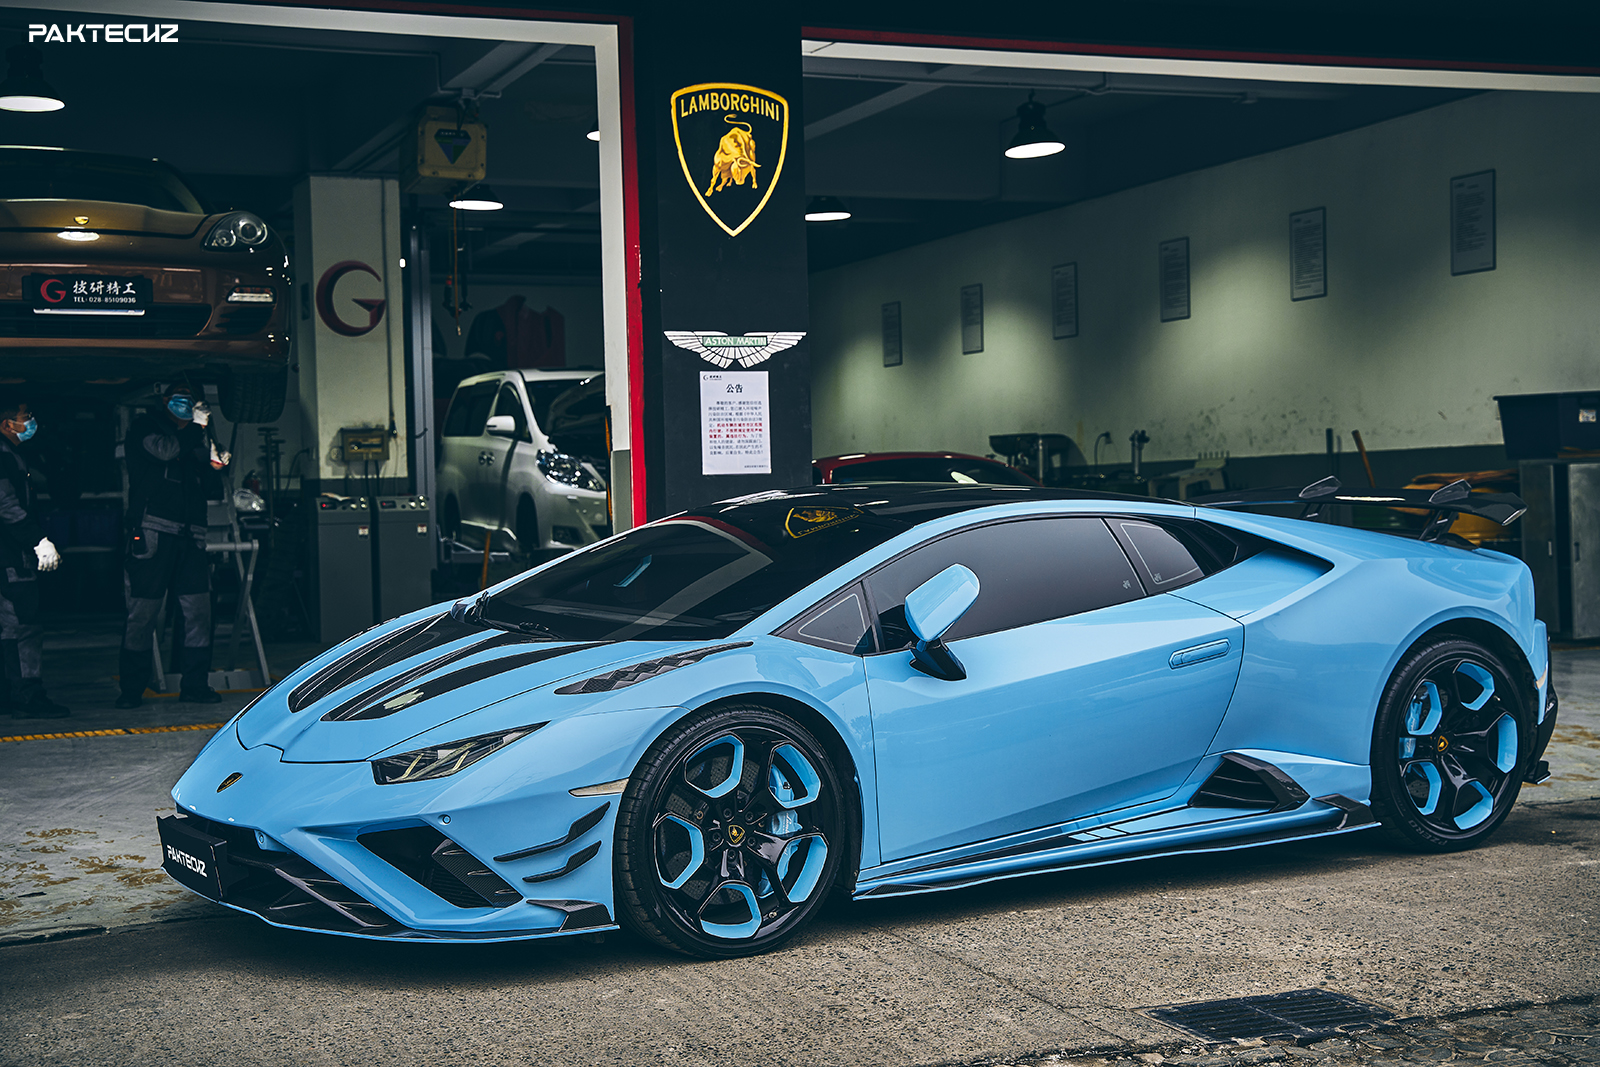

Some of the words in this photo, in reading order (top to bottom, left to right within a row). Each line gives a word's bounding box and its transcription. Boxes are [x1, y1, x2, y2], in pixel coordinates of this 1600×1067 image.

[680, 92, 780, 122] LAMBORGHINI
[73, 280, 136, 295] 技研精工
[705, 337, 734, 346] ASTON
[736, 337, 767, 346] MARTIN
[725, 383, 744, 394] 公告
